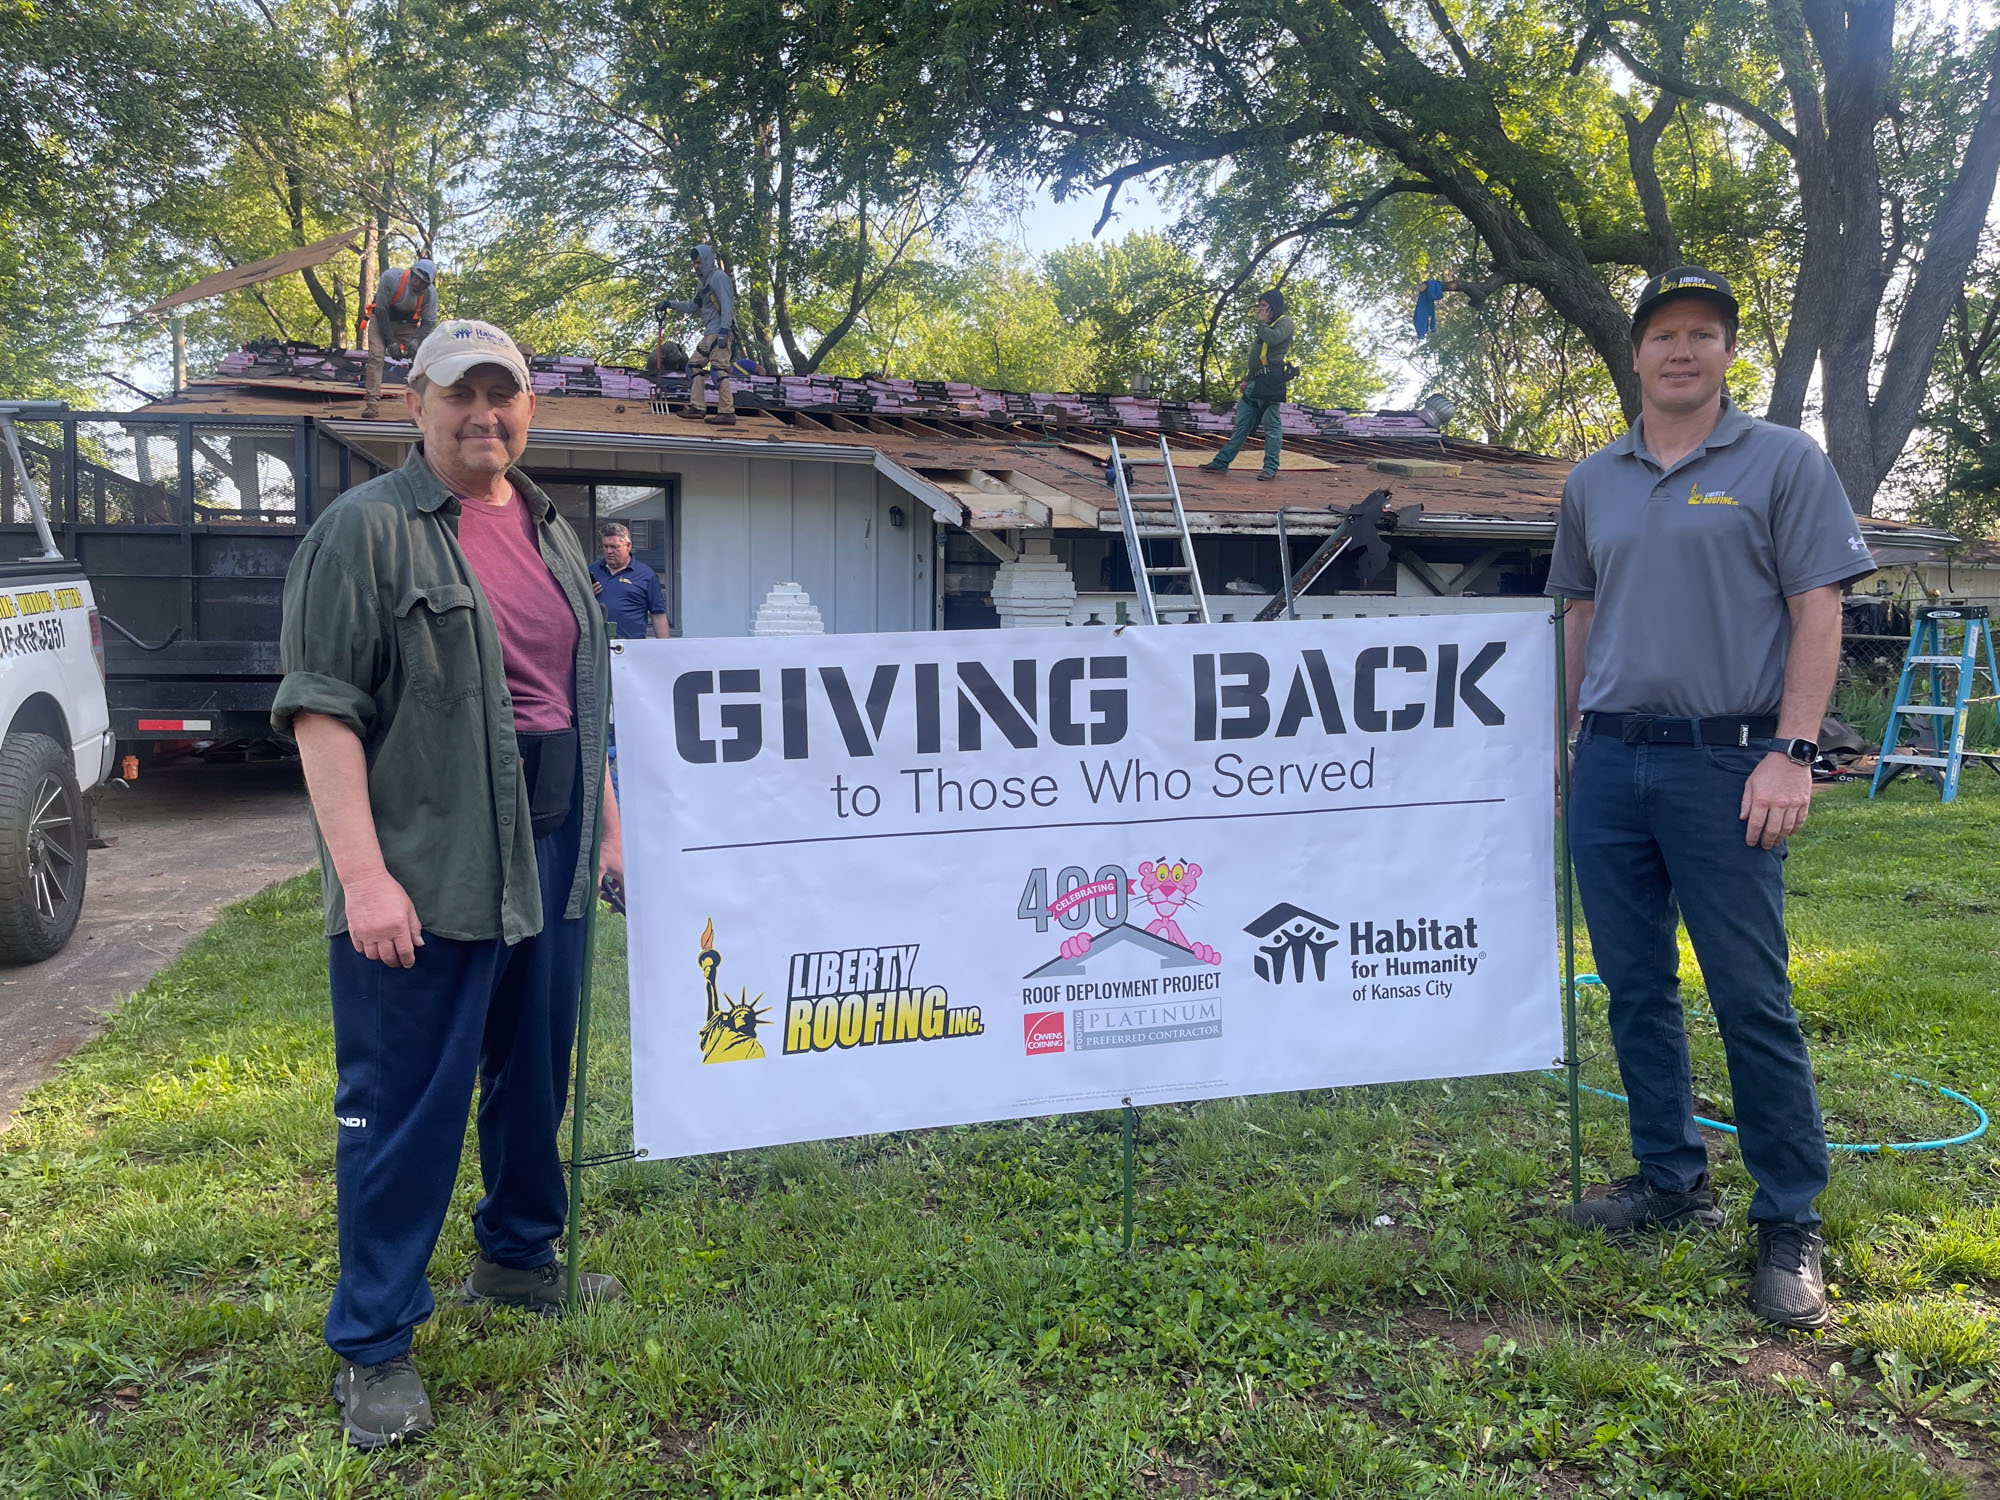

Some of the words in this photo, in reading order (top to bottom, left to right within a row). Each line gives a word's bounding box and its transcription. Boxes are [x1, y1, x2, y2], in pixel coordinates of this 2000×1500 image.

[1703, 496, 1733, 504] ROOFING
[15, 590, 55, 616] WINDOWS
[0, 618, 65, 658] 16.415.3551
[673, 656, 1128, 764] GIVING
[1193, 641, 1507, 742] BACK
[831, 774, 881, 818] to
[900, 763, 1059, 814] Those
[1081, 758, 1191, 804] Who
[1212, 747, 1375, 799] Served
[1017, 864, 1129, 933] 400
[1055, 883, 1114, 911] CELEBRATING
[1350, 917, 1478, 956] Habitat
[788, 944, 920, 1000] LIBERTY
[1351, 960, 1378, 979] for
[1386, 953, 1478, 976] Humanity
[1022, 986, 1061, 1005] ROOF
[1066, 978, 1159, 1001] DEPLOYMENT
[1163, 972, 1221, 994] PROJECT
[1352, 986, 1368, 1002] of
[1371, 983, 1421, 1000] Kansas
[1425, 980, 1453, 998] City
[783, 985, 948, 1055] ROOFING
[947, 1005, 985, 1038] INC.
[1075, 1011, 1084, 1050] ROOFING
[1089, 1002, 1216, 1029] PLATINUM
[1028, 1040, 1063, 1050] CORNING
[1033, 1032, 1063, 1042] OWENS
[1086, 1033, 1146, 1046] PREFERRED
[1149, 1024, 1220, 1041] CONTRACTOR
